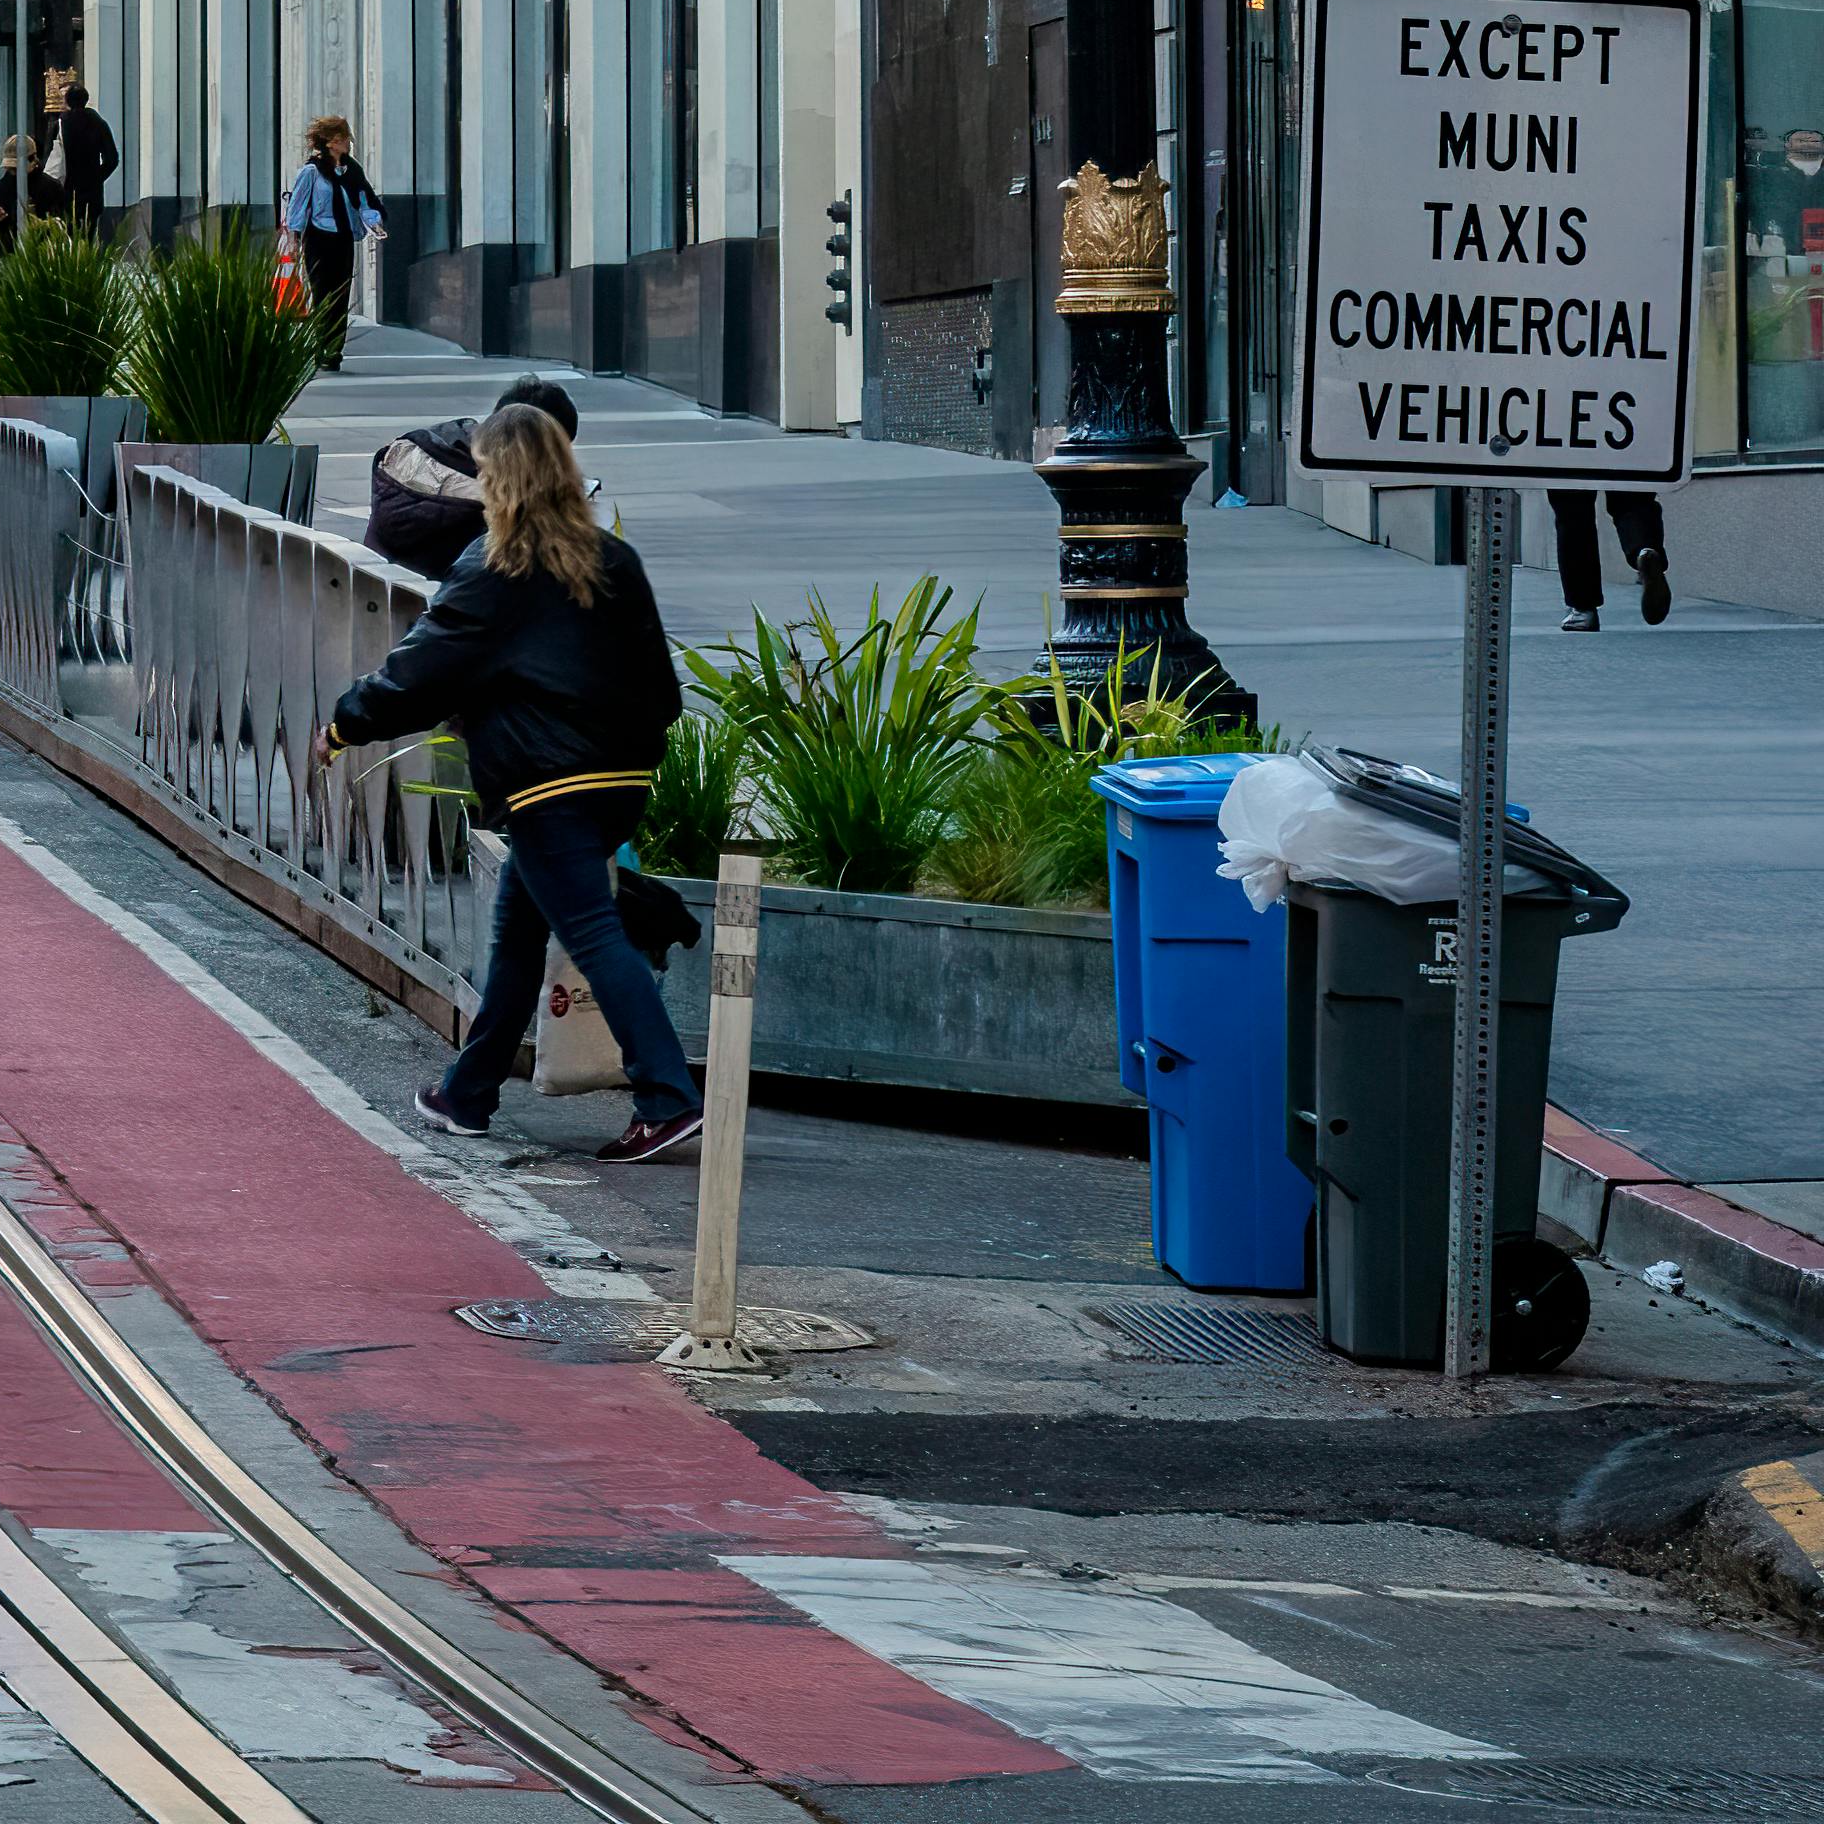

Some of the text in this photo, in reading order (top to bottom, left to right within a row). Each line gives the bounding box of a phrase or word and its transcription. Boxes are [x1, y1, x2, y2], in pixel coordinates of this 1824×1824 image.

[1400, 18, 1621, 85] EXCEPT
[1438, 111, 1578, 174] MUNI
[1423, 202, 1588, 266] TAXIS
[1329, 289, 1667, 360] COMMERCIAL
[1358, 382, 1636, 451] VEHICLES
